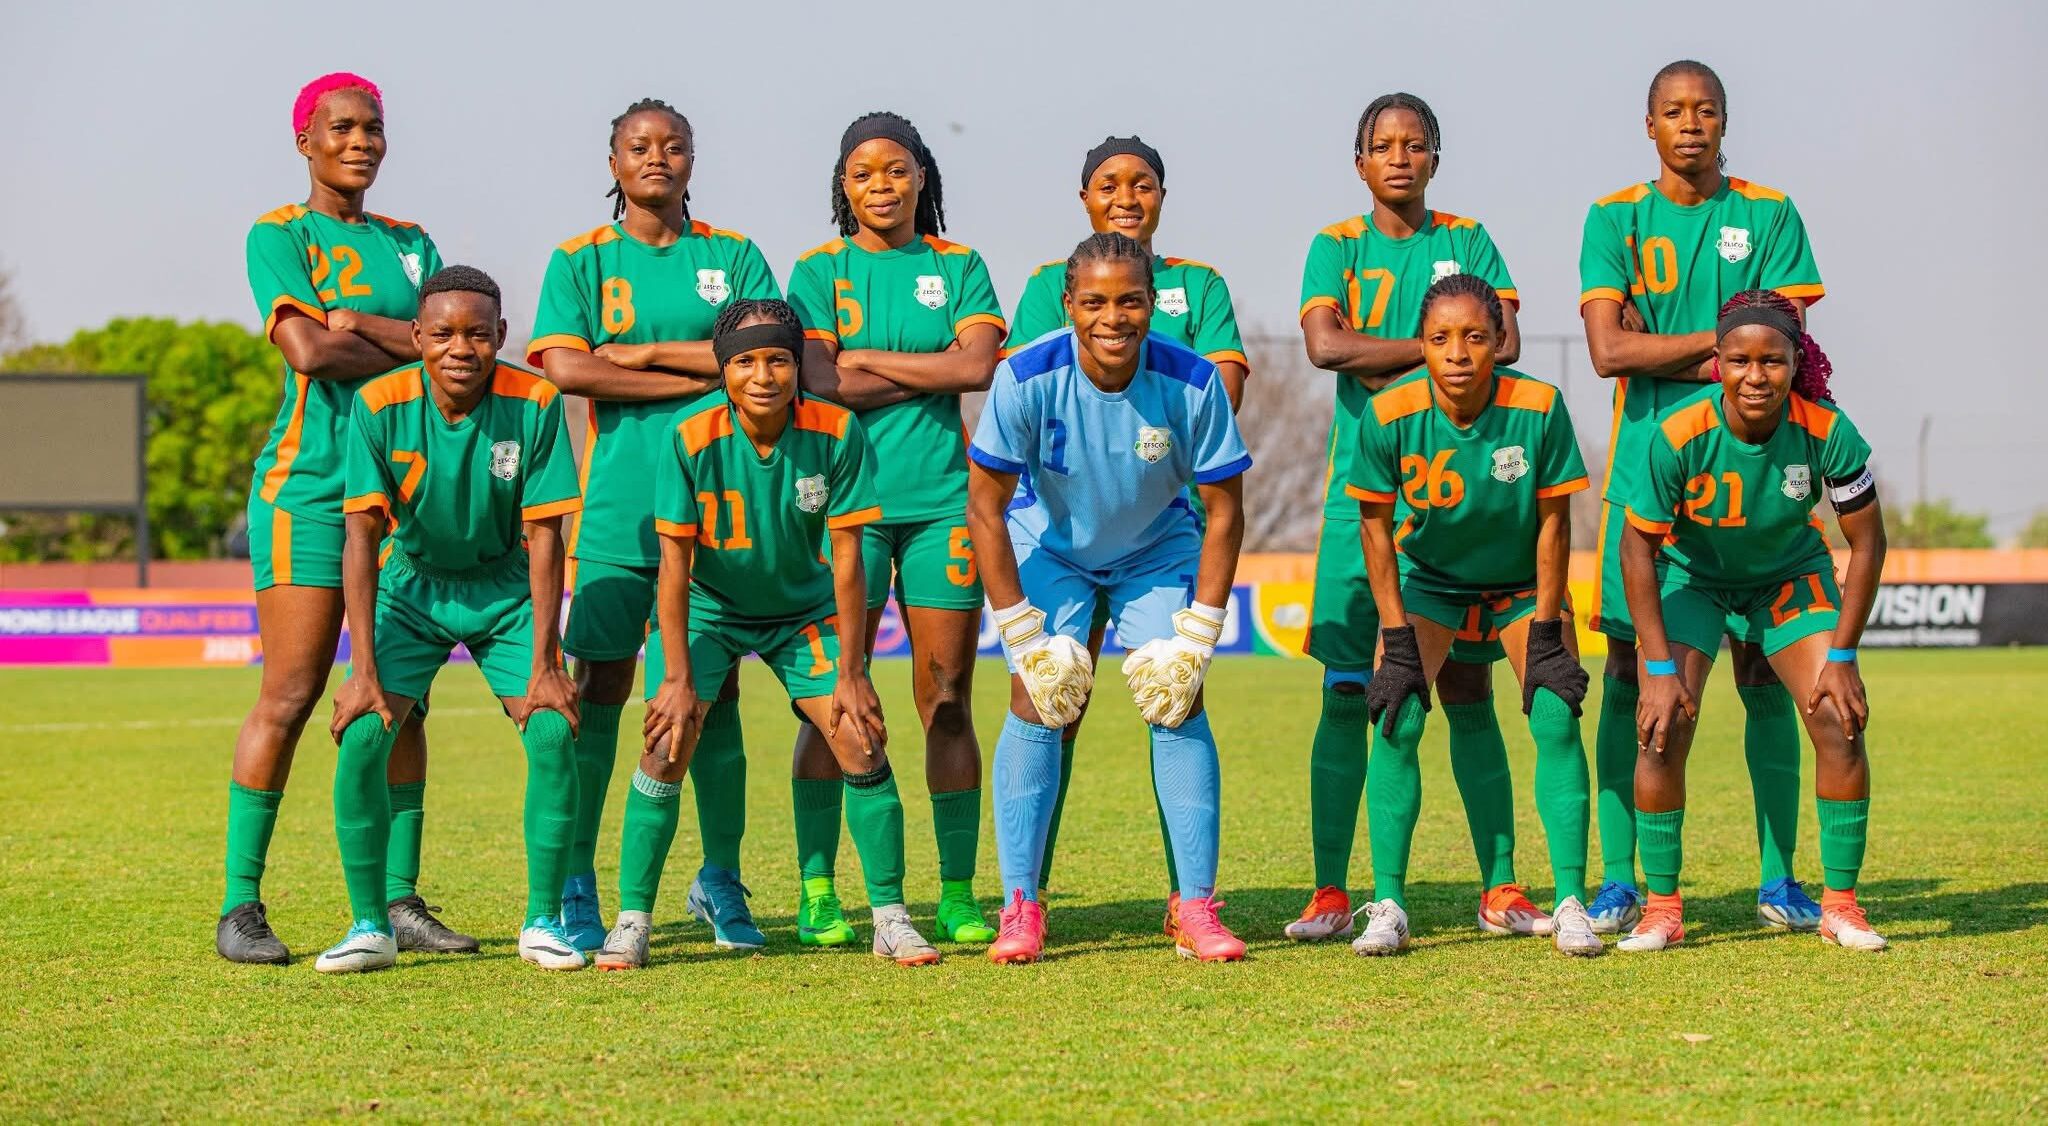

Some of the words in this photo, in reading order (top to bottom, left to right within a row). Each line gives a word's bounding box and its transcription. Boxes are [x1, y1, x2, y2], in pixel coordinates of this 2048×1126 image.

[307, 246, 372, 302] 22
[1625, 236, 1679, 295] 10
[601, 278, 635, 335] 8
[834, 279, 863, 337] 5
[1342, 268, 1395, 329] 17
[497, 457, 517, 465] ZESCO
[1042, 418, 1069, 476] 1
[1500, 461, 1520, 470] ZESCO
[391, 450, 427, 505] 7
[804, 490, 823, 499] ZESCO
[1400, 449, 1465, 509] 26
[1685, 472, 1747, 528] 21
[697, 489, 753, 549] 11
[946, 526, 977, 588] 5
[1769, 573, 1835, 627] 21
